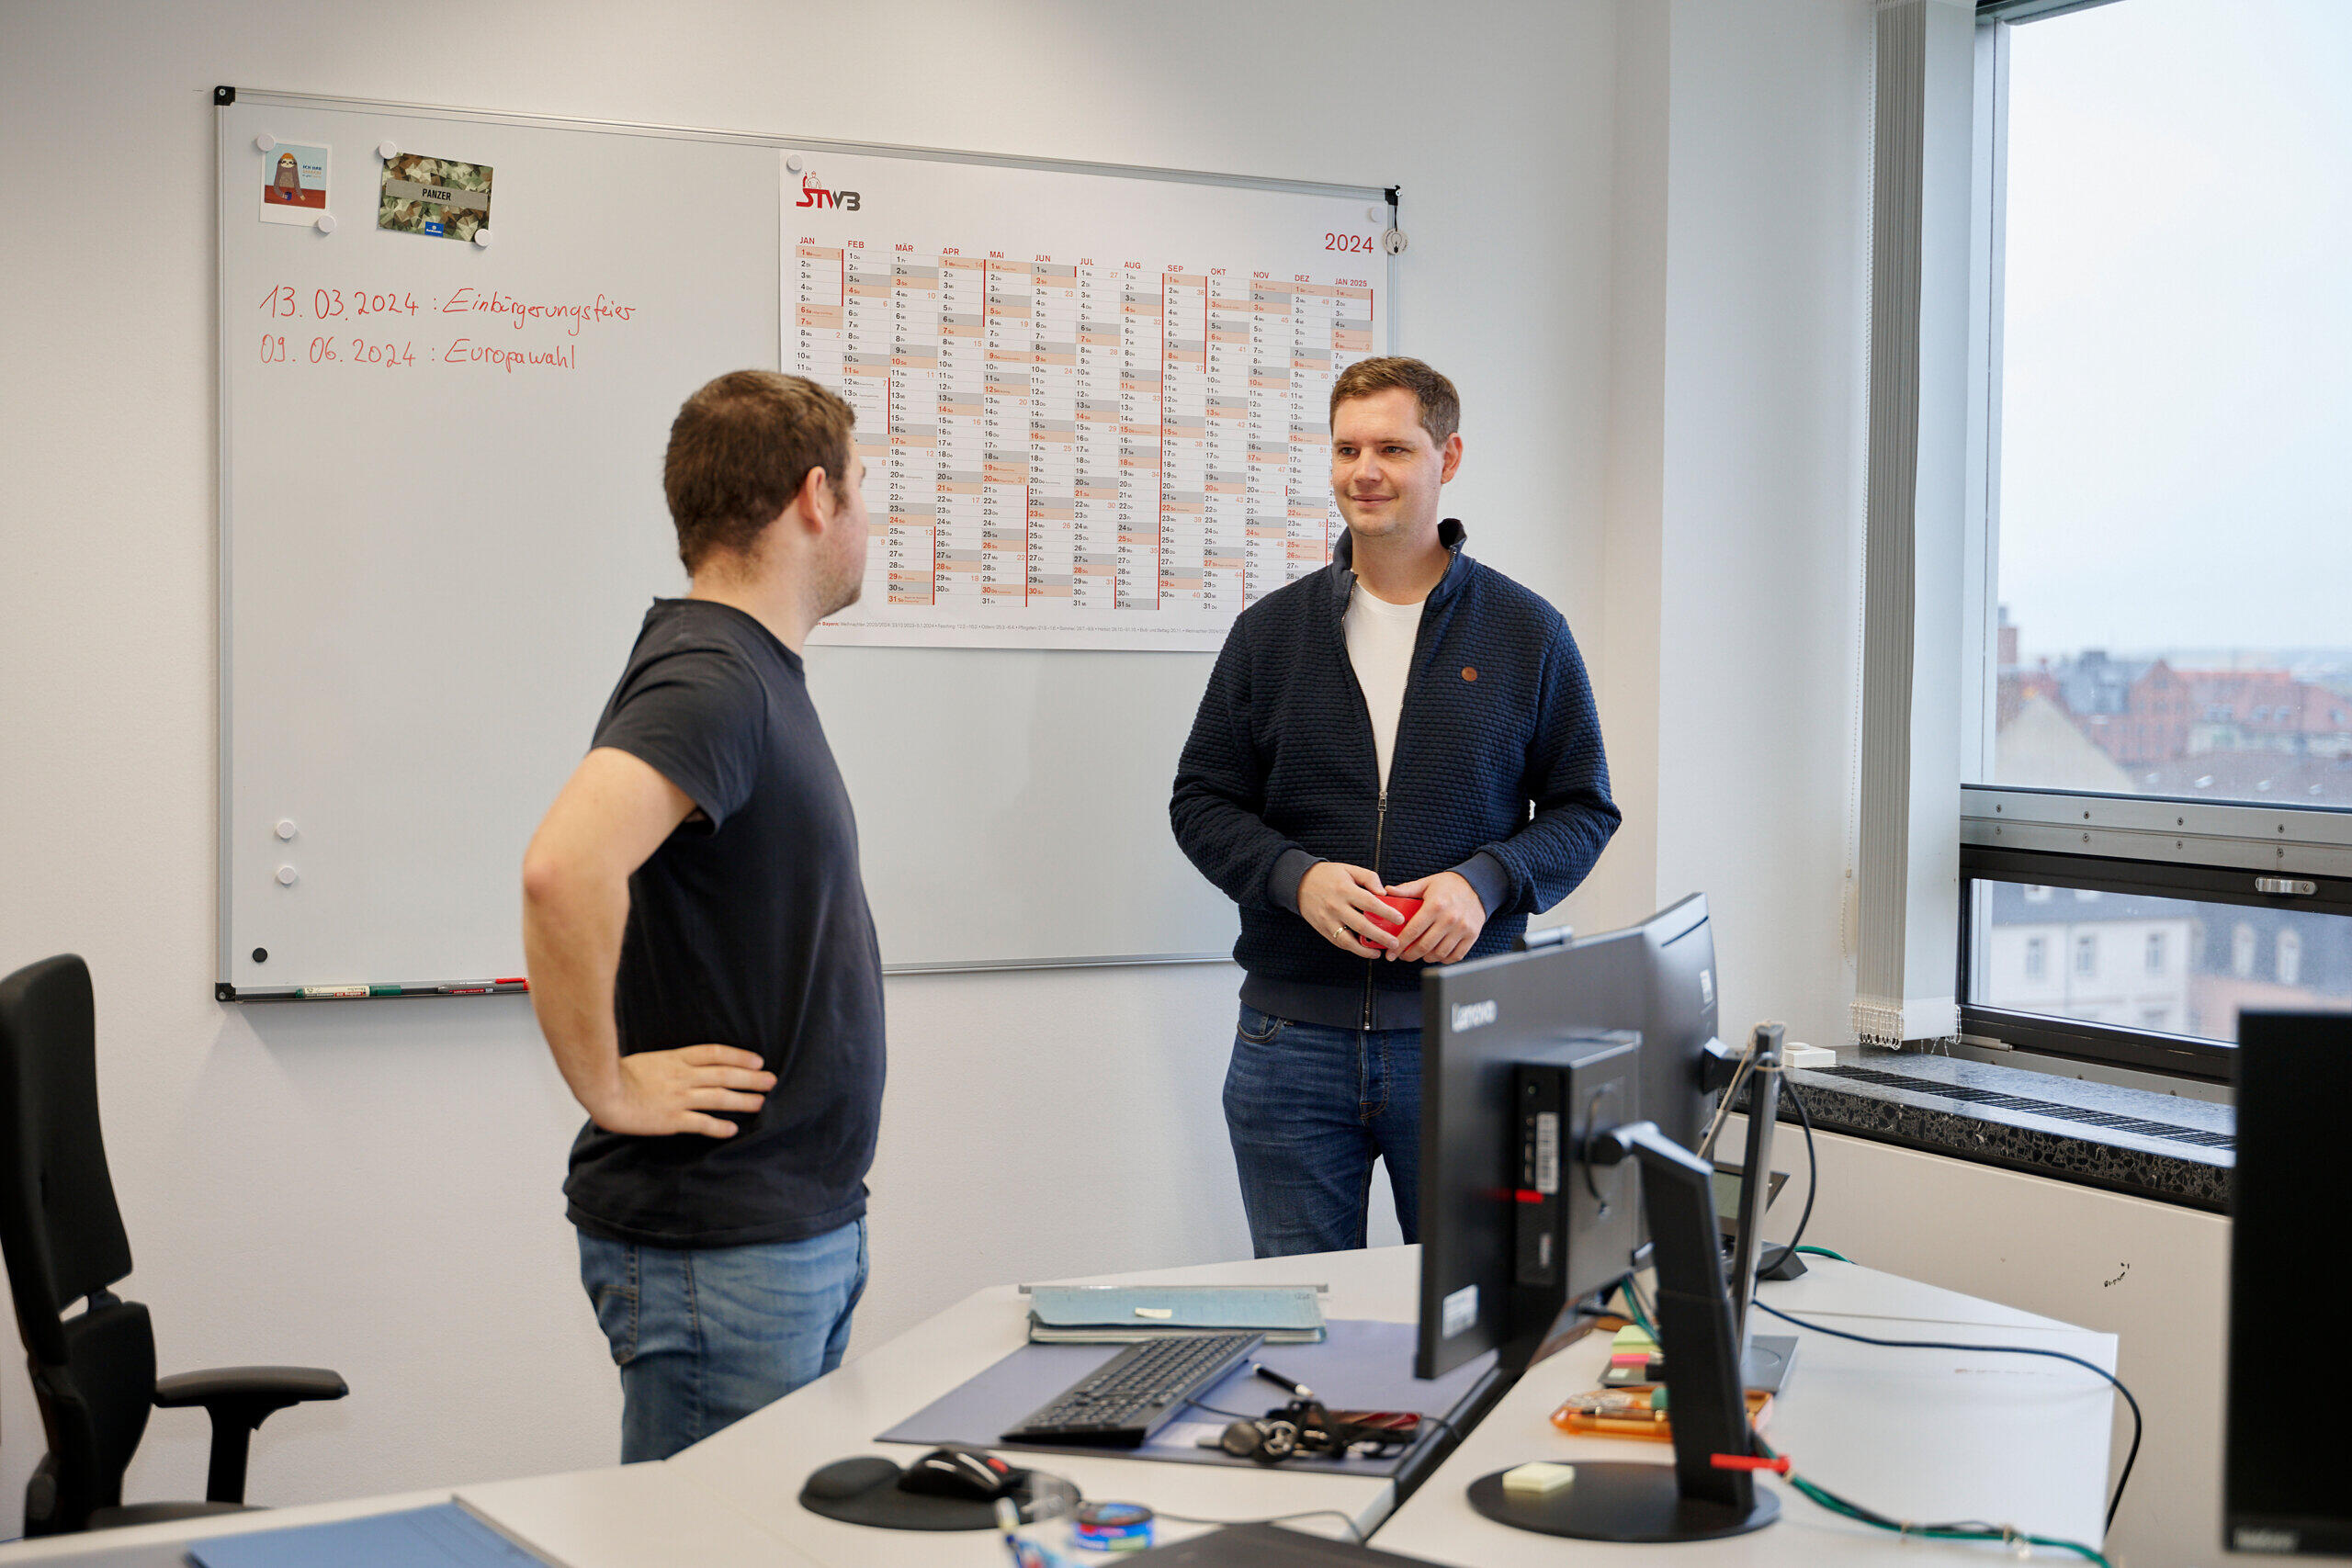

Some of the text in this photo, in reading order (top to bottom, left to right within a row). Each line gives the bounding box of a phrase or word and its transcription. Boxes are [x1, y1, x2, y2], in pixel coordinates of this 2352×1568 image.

[422, 187, 451, 201] PANZER
[799, 237, 815, 245] JAN
[847, 240, 865, 249] FEB
[1326, 233, 1374, 254] 2024
[896, 243, 914, 253] MÄR
[943, 247, 960, 255] APR
[989, 250, 1005, 259] MAI
[1035, 254, 1051, 263] JUN
[1080, 257, 1094, 266] JUL
[1124, 261, 1141, 269] AUG
[1167, 264, 1183, 273] SEP
[1211, 267, 1227, 276] OKT
[1253, 271, 1270, 279] NOV
[1295, 274, 1310, 283] DEZ
[1335, 277, 1368, 288] JAN 2025
[443, 288, 636, 336] Einbürgerungsfeier
[445, 334, 577, 373] Europawahl
[1451, 999, 1498, 1033] Lenovo
